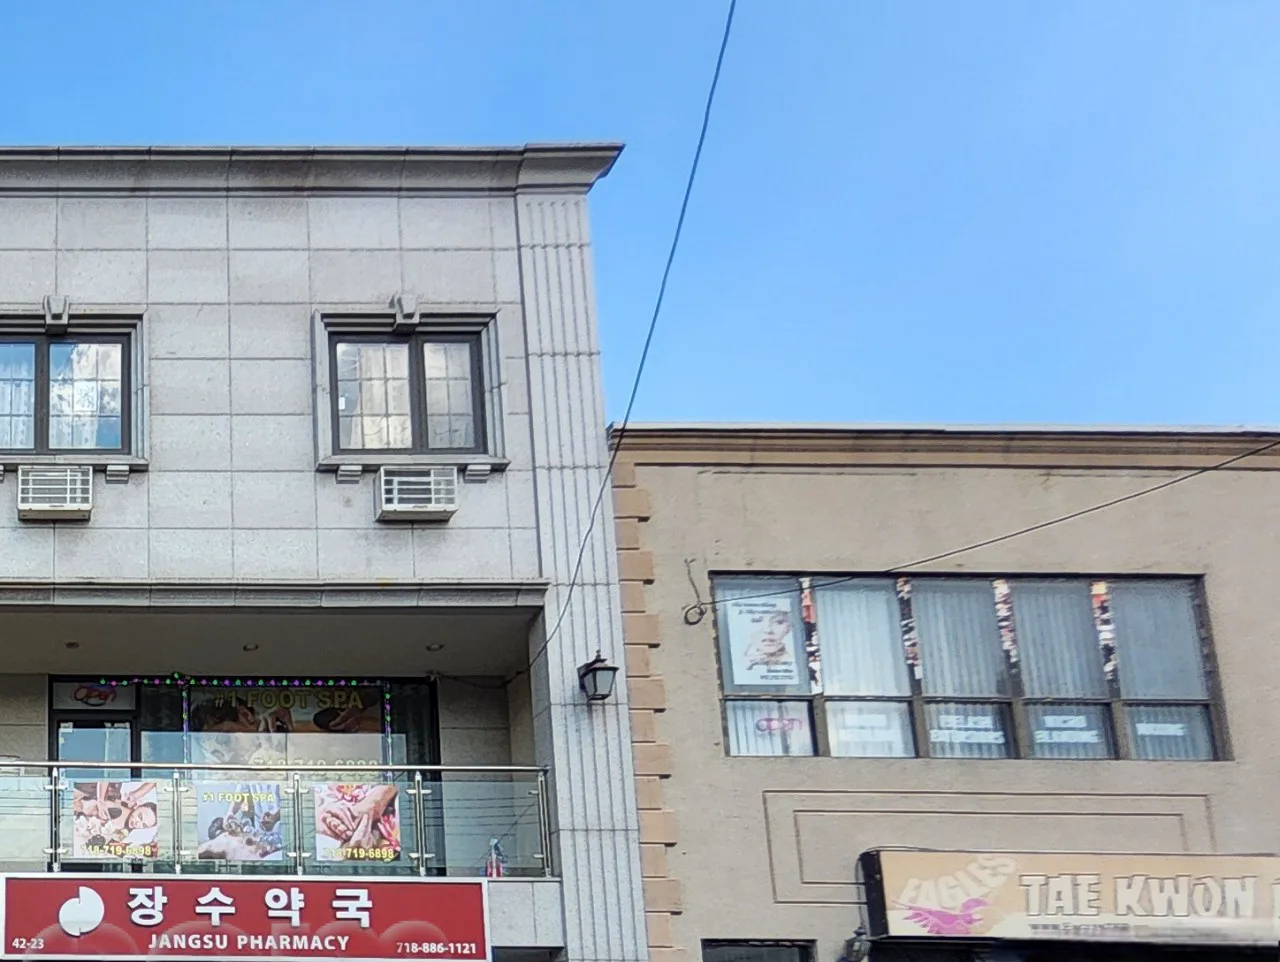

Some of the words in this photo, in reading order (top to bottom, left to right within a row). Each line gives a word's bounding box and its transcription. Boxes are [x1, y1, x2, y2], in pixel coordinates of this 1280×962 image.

[214, 691, 239, 709] #1
[246, 690, 312, 709] FOOT
[317, 690, 364, 709] SPA
[219, 793, 249, 802] FOOT
[252, 793, 274, 802] SPA
[900, 855, 1016, 910] EAGLES
[1021, 872, 1101, 917] TAE
[1114, 873, 1257, 919] KWON
[12, 938, 45, 951] 42-23
[148, 932, 228, 951] JANGSU
[236, 933, 350, 952] PHARMACY
[396, 941, 478, 955] 718-886-1121
